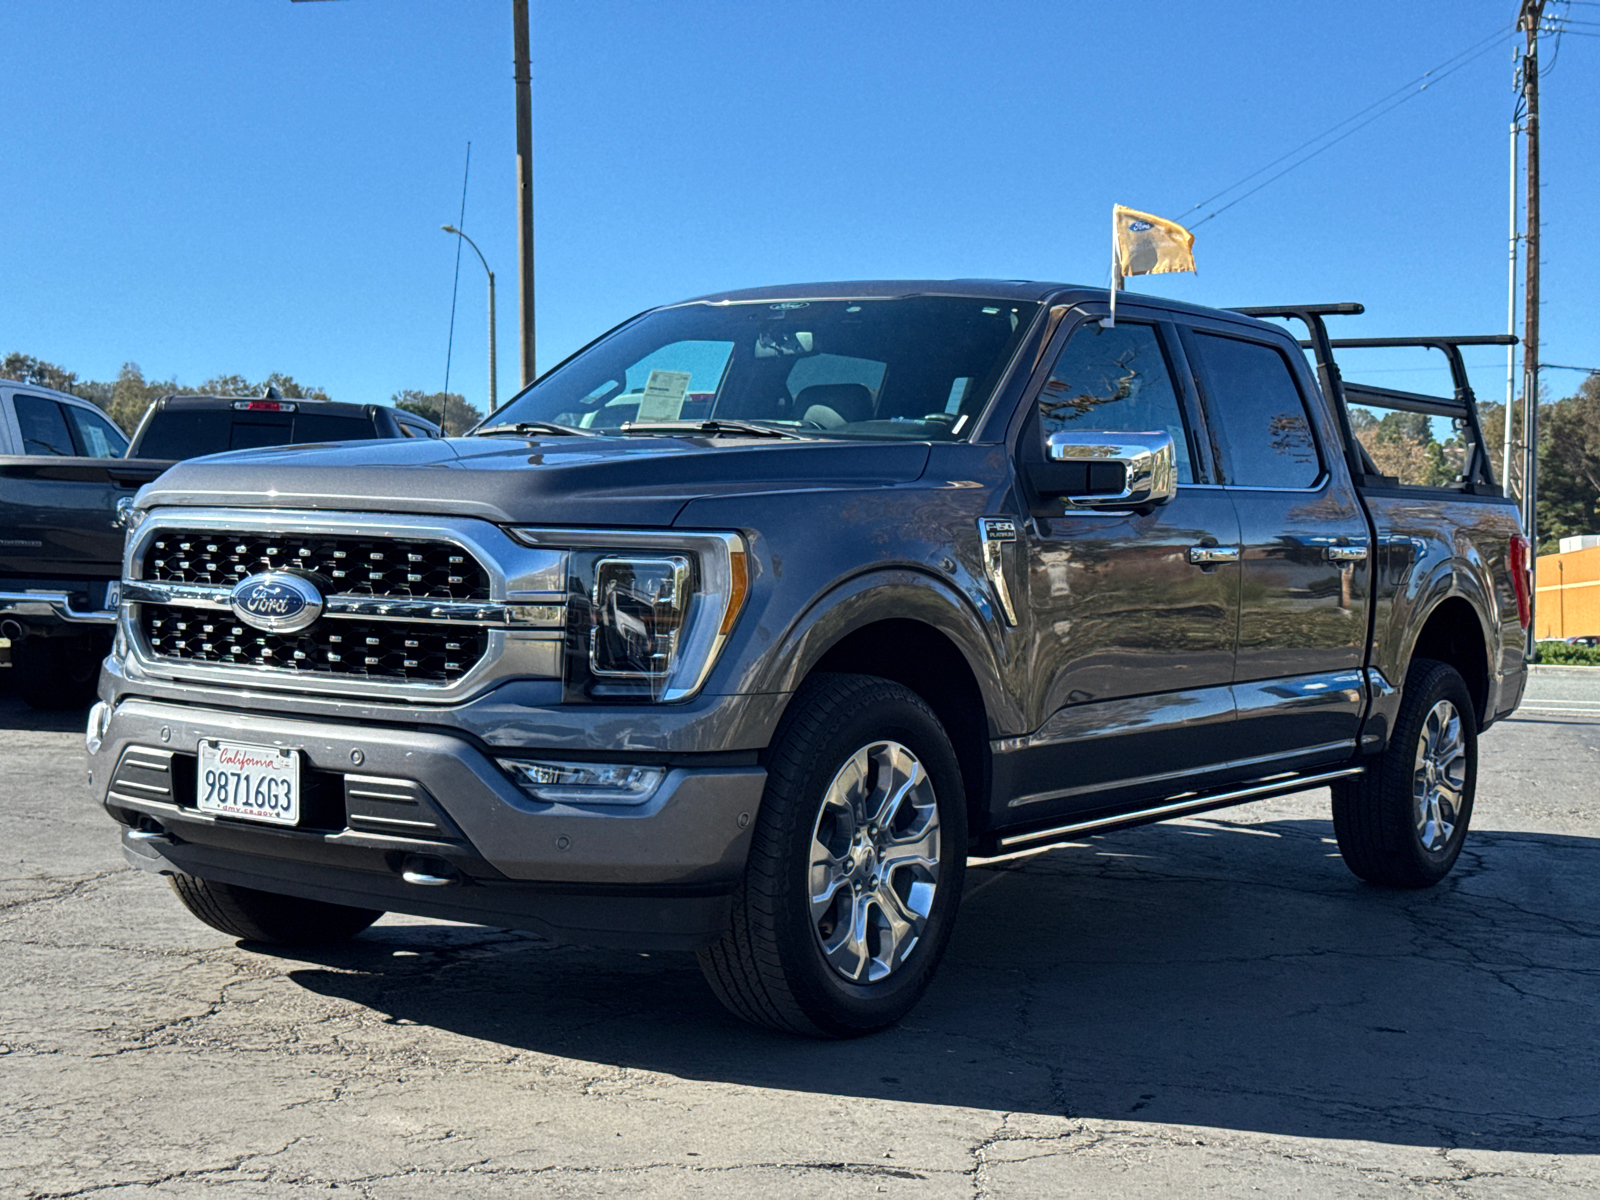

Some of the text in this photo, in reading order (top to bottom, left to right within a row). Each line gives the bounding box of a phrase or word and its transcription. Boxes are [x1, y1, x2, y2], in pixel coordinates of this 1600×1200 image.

[1133, 222, 1150, 231] Ford
[986, 522, 1014, 531] F-150
[247, 585, 289, 612] Ford
[219, 748, 280, 770] California
[204, 769, 292, 812] 98716G3
[222, 805, 274, 817] dmv.ca.gov
